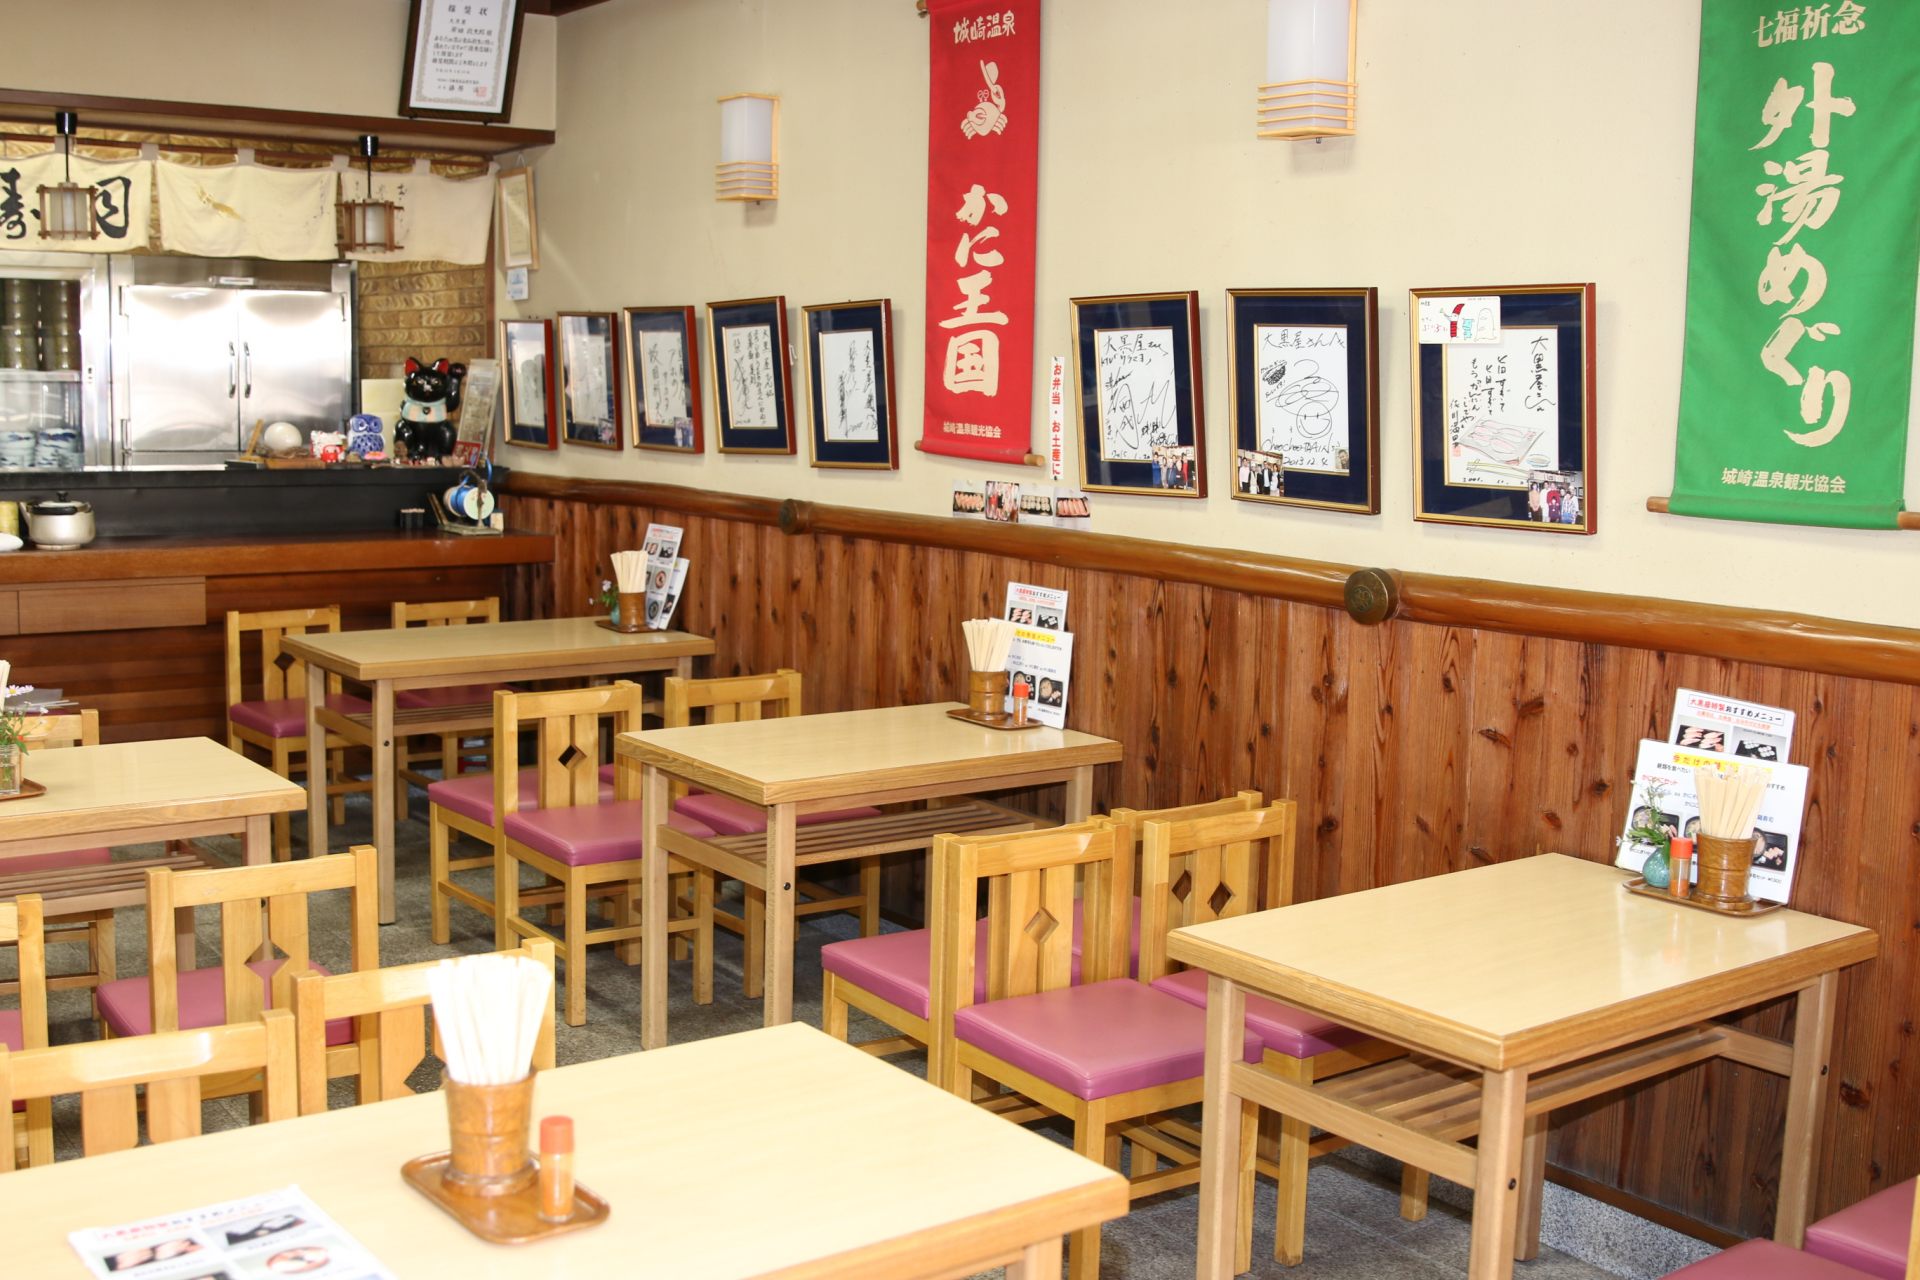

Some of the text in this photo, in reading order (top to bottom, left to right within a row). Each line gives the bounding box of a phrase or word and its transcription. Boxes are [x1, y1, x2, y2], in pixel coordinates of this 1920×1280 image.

[952, 10, 1017, 44] 城崎温泉
[1752, 0, 1867, 48] 七福祈念
[1748, 61, 1857, 448] 外湯めぐり
[938, 183, 1010, 397] かに王国
[943, 420, 1003, 439] 城崎温泉観光協会
[1051, 362, 1063, 476] お弁当・お土産に
[1720, 467, 1847, 495] 城崎温泉観光協会
